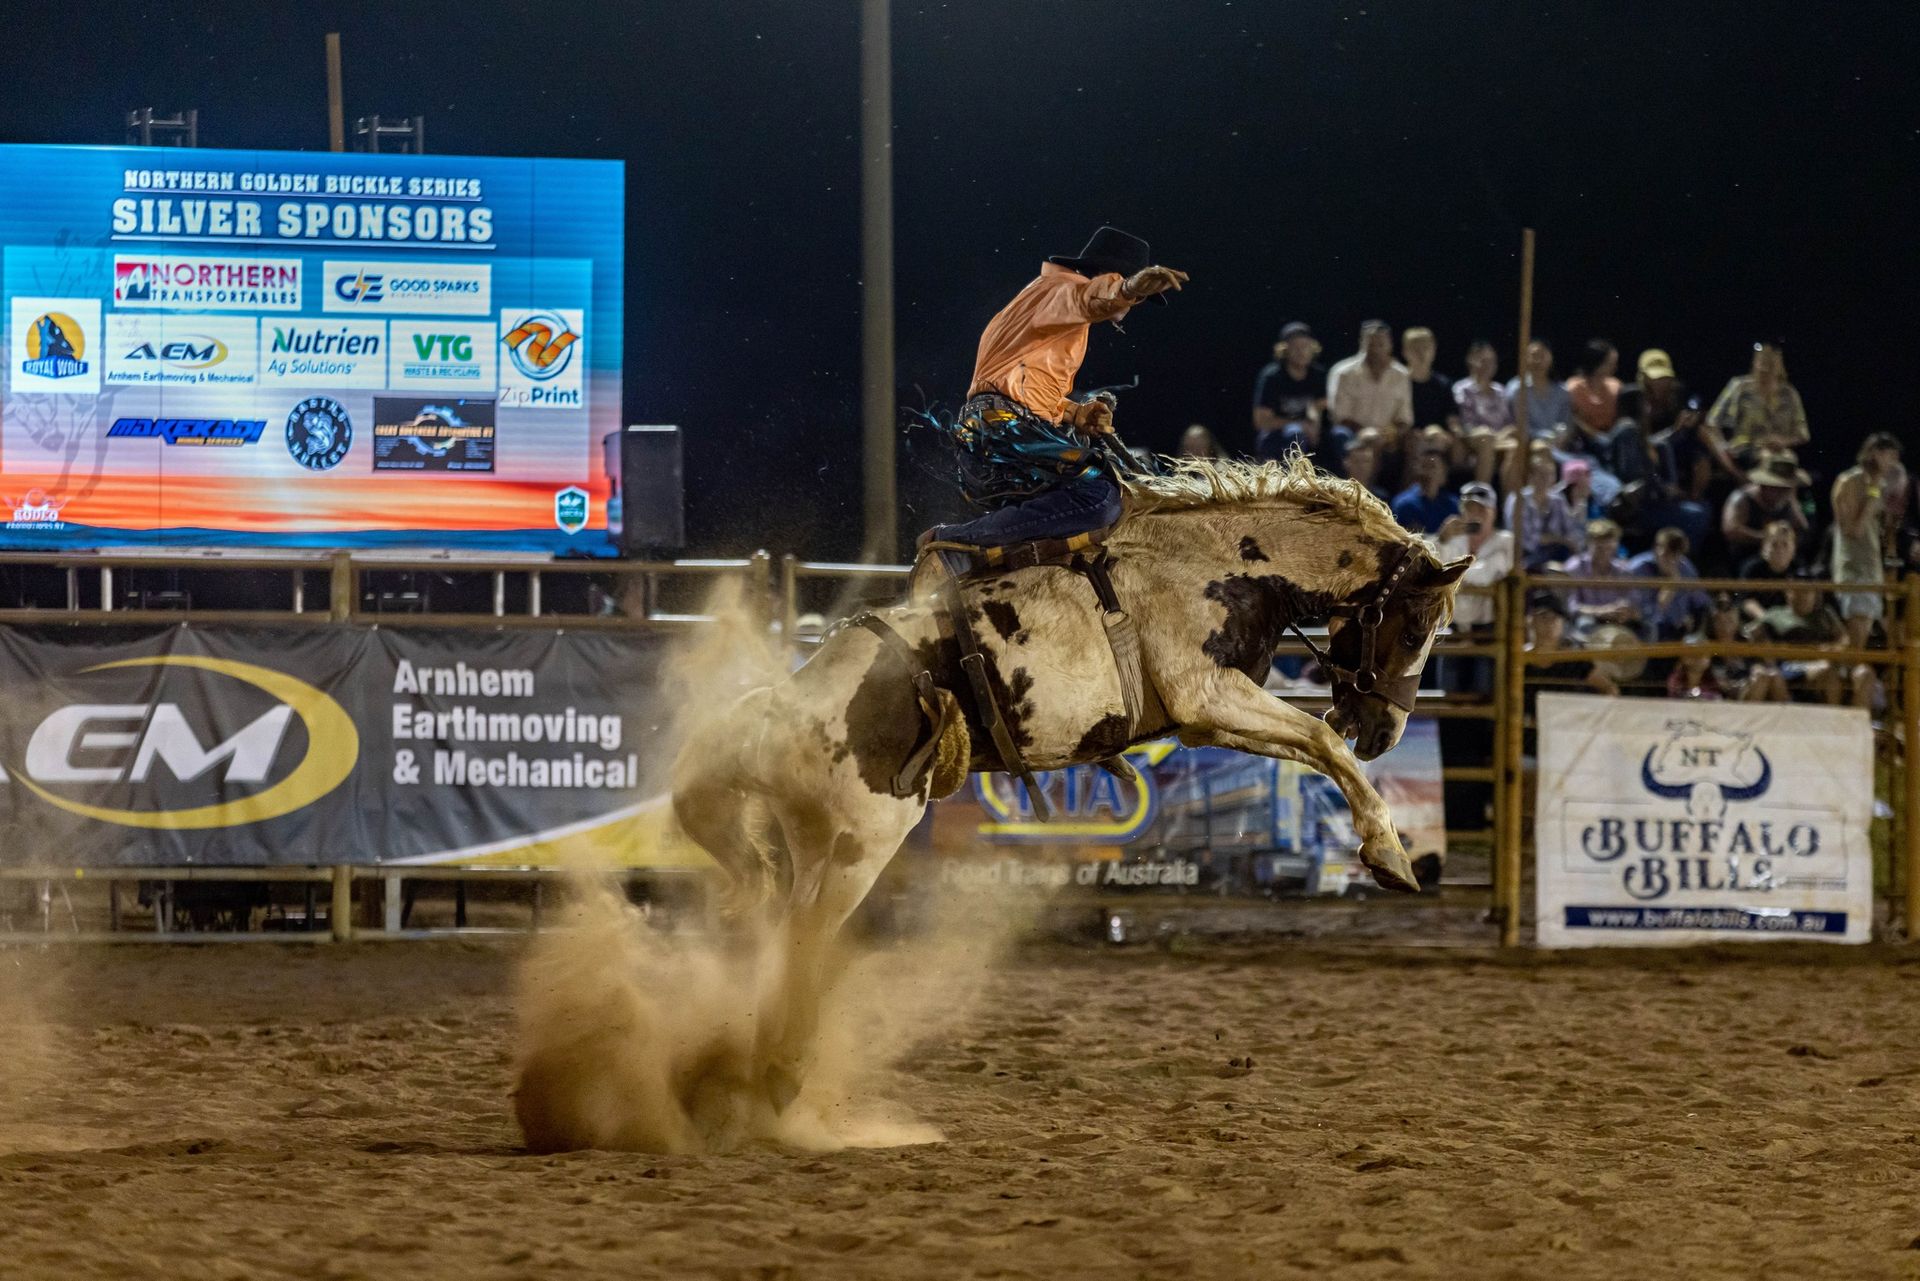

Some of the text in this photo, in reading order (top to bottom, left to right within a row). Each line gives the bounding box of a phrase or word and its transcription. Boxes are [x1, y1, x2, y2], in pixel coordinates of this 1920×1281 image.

[124, 170, 481, 197] NORTHERN GOLDEN BUCKLE SERIES
[113, 198, 493, 242] SILVER SPONSORS
[152, 263, 297, 288] NORTHERN
[390, 279, 480, 294] GOOD SPARKS
[152, 289, 297, 305] TRANSPORTABLES
[124, 342, 218, 361] AEM
[271, 327, 380, 355] Nutrien
[413, 334, 472, 361] VTG
[108, 371, 254, 384] Arnhem Earthmoving & Mechanical
[268, 359, 351, 376] Ag Solutions
[393, 659, 535, 697] Arnhem
[392, 703, 621, 750] Earthmoving
[0, 703, 294, 782] EM
[393, 749, 638, 788] & Mechanical
[1681, 748, 1722, 767] NT
[1582, 818, 1820, 861] BUFFALO
[1076, 861, 1100, 885] of
[1103, 859, 1199, 885] Australia
[1623, 858, 1773, 901] BILLS
[1587, 908, 1827, 932] www.buffalobills.com.au
